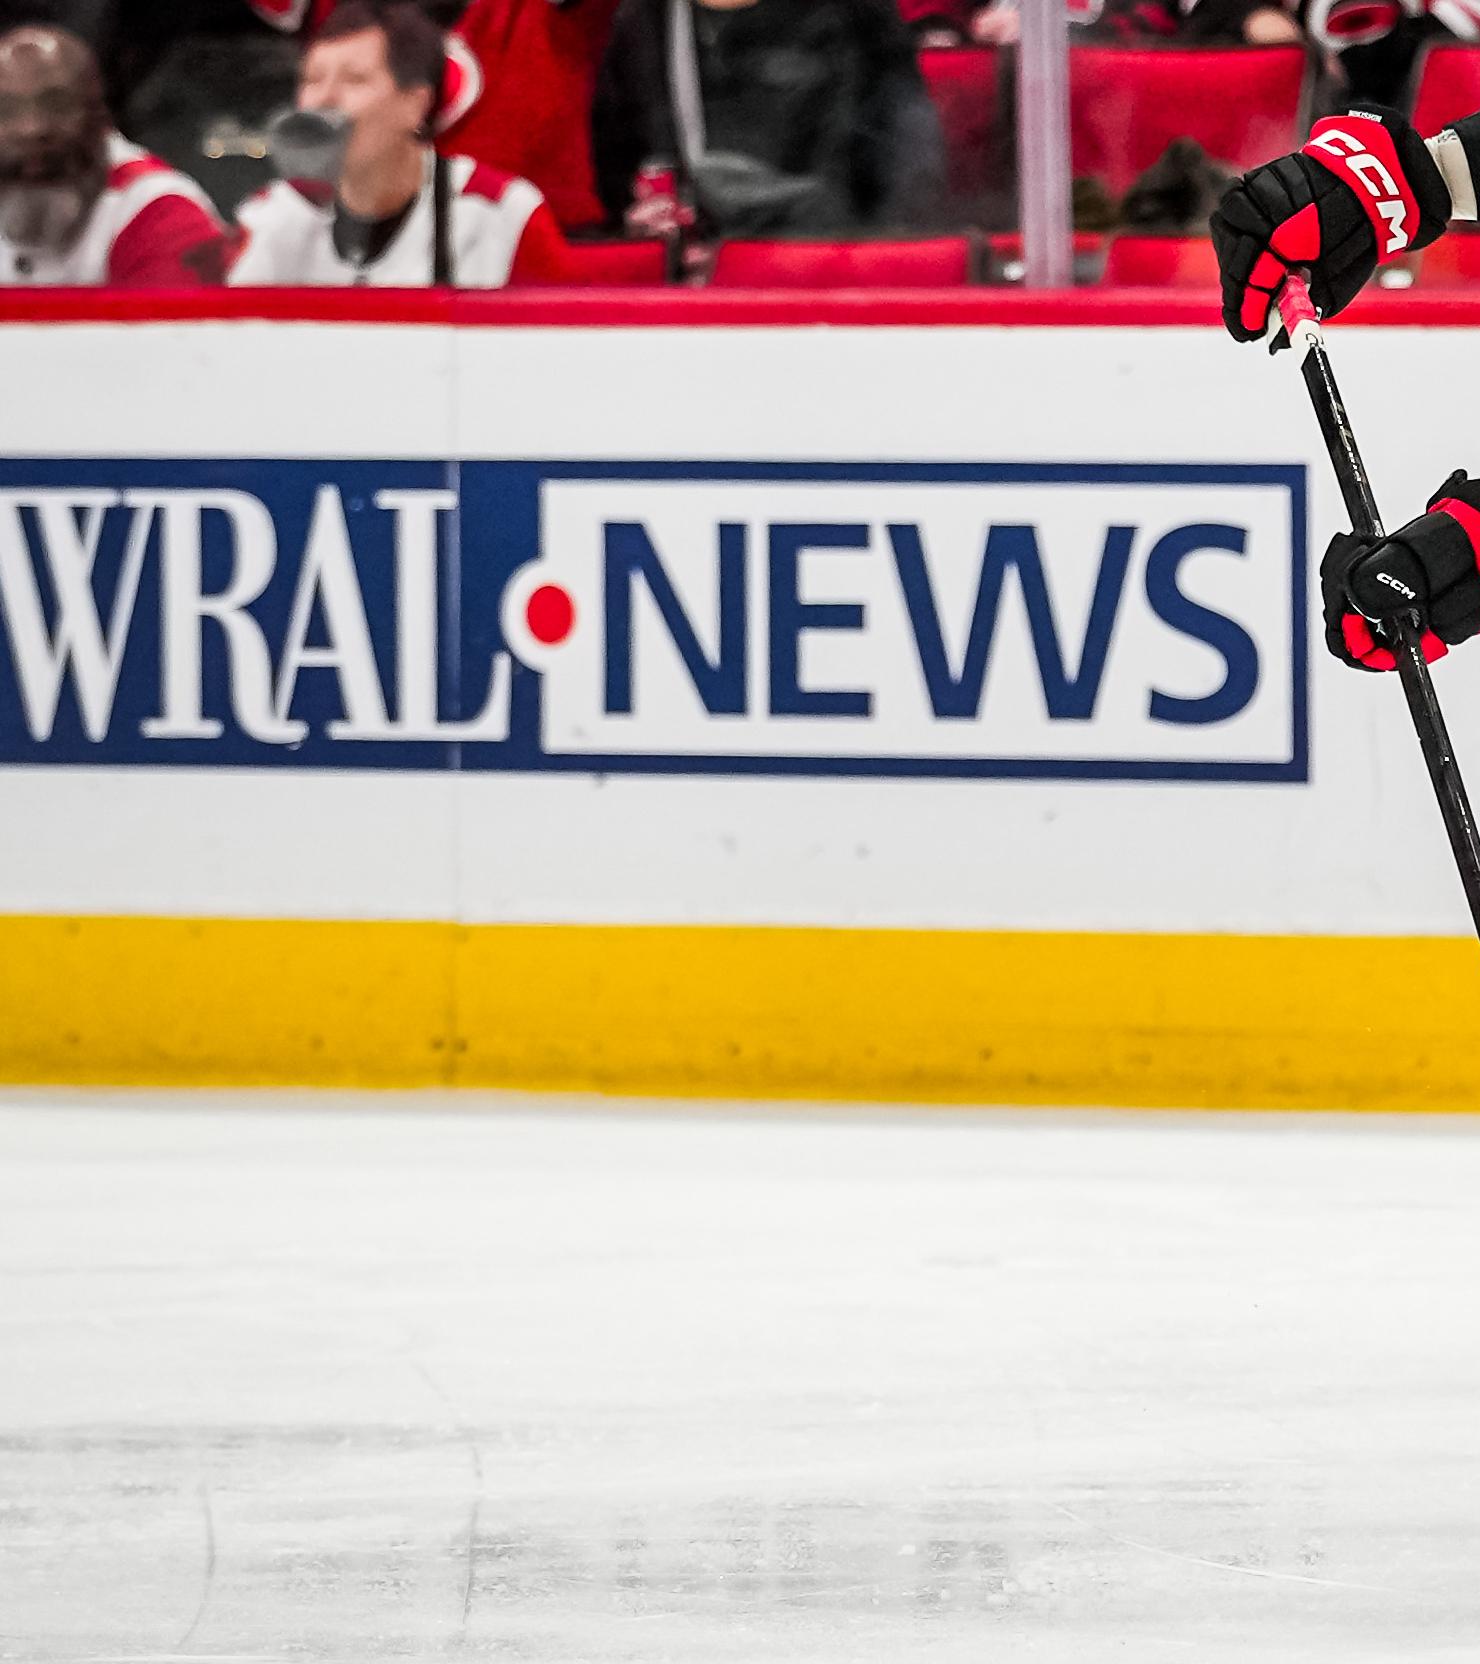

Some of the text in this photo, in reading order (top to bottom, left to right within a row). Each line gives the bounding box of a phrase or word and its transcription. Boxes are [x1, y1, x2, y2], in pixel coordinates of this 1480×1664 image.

[1310, 128, 1409, 254] CCM
[0, 484, 1262, 745] WRAL NEWS
[1376, 572, 1417, 600] CCM
